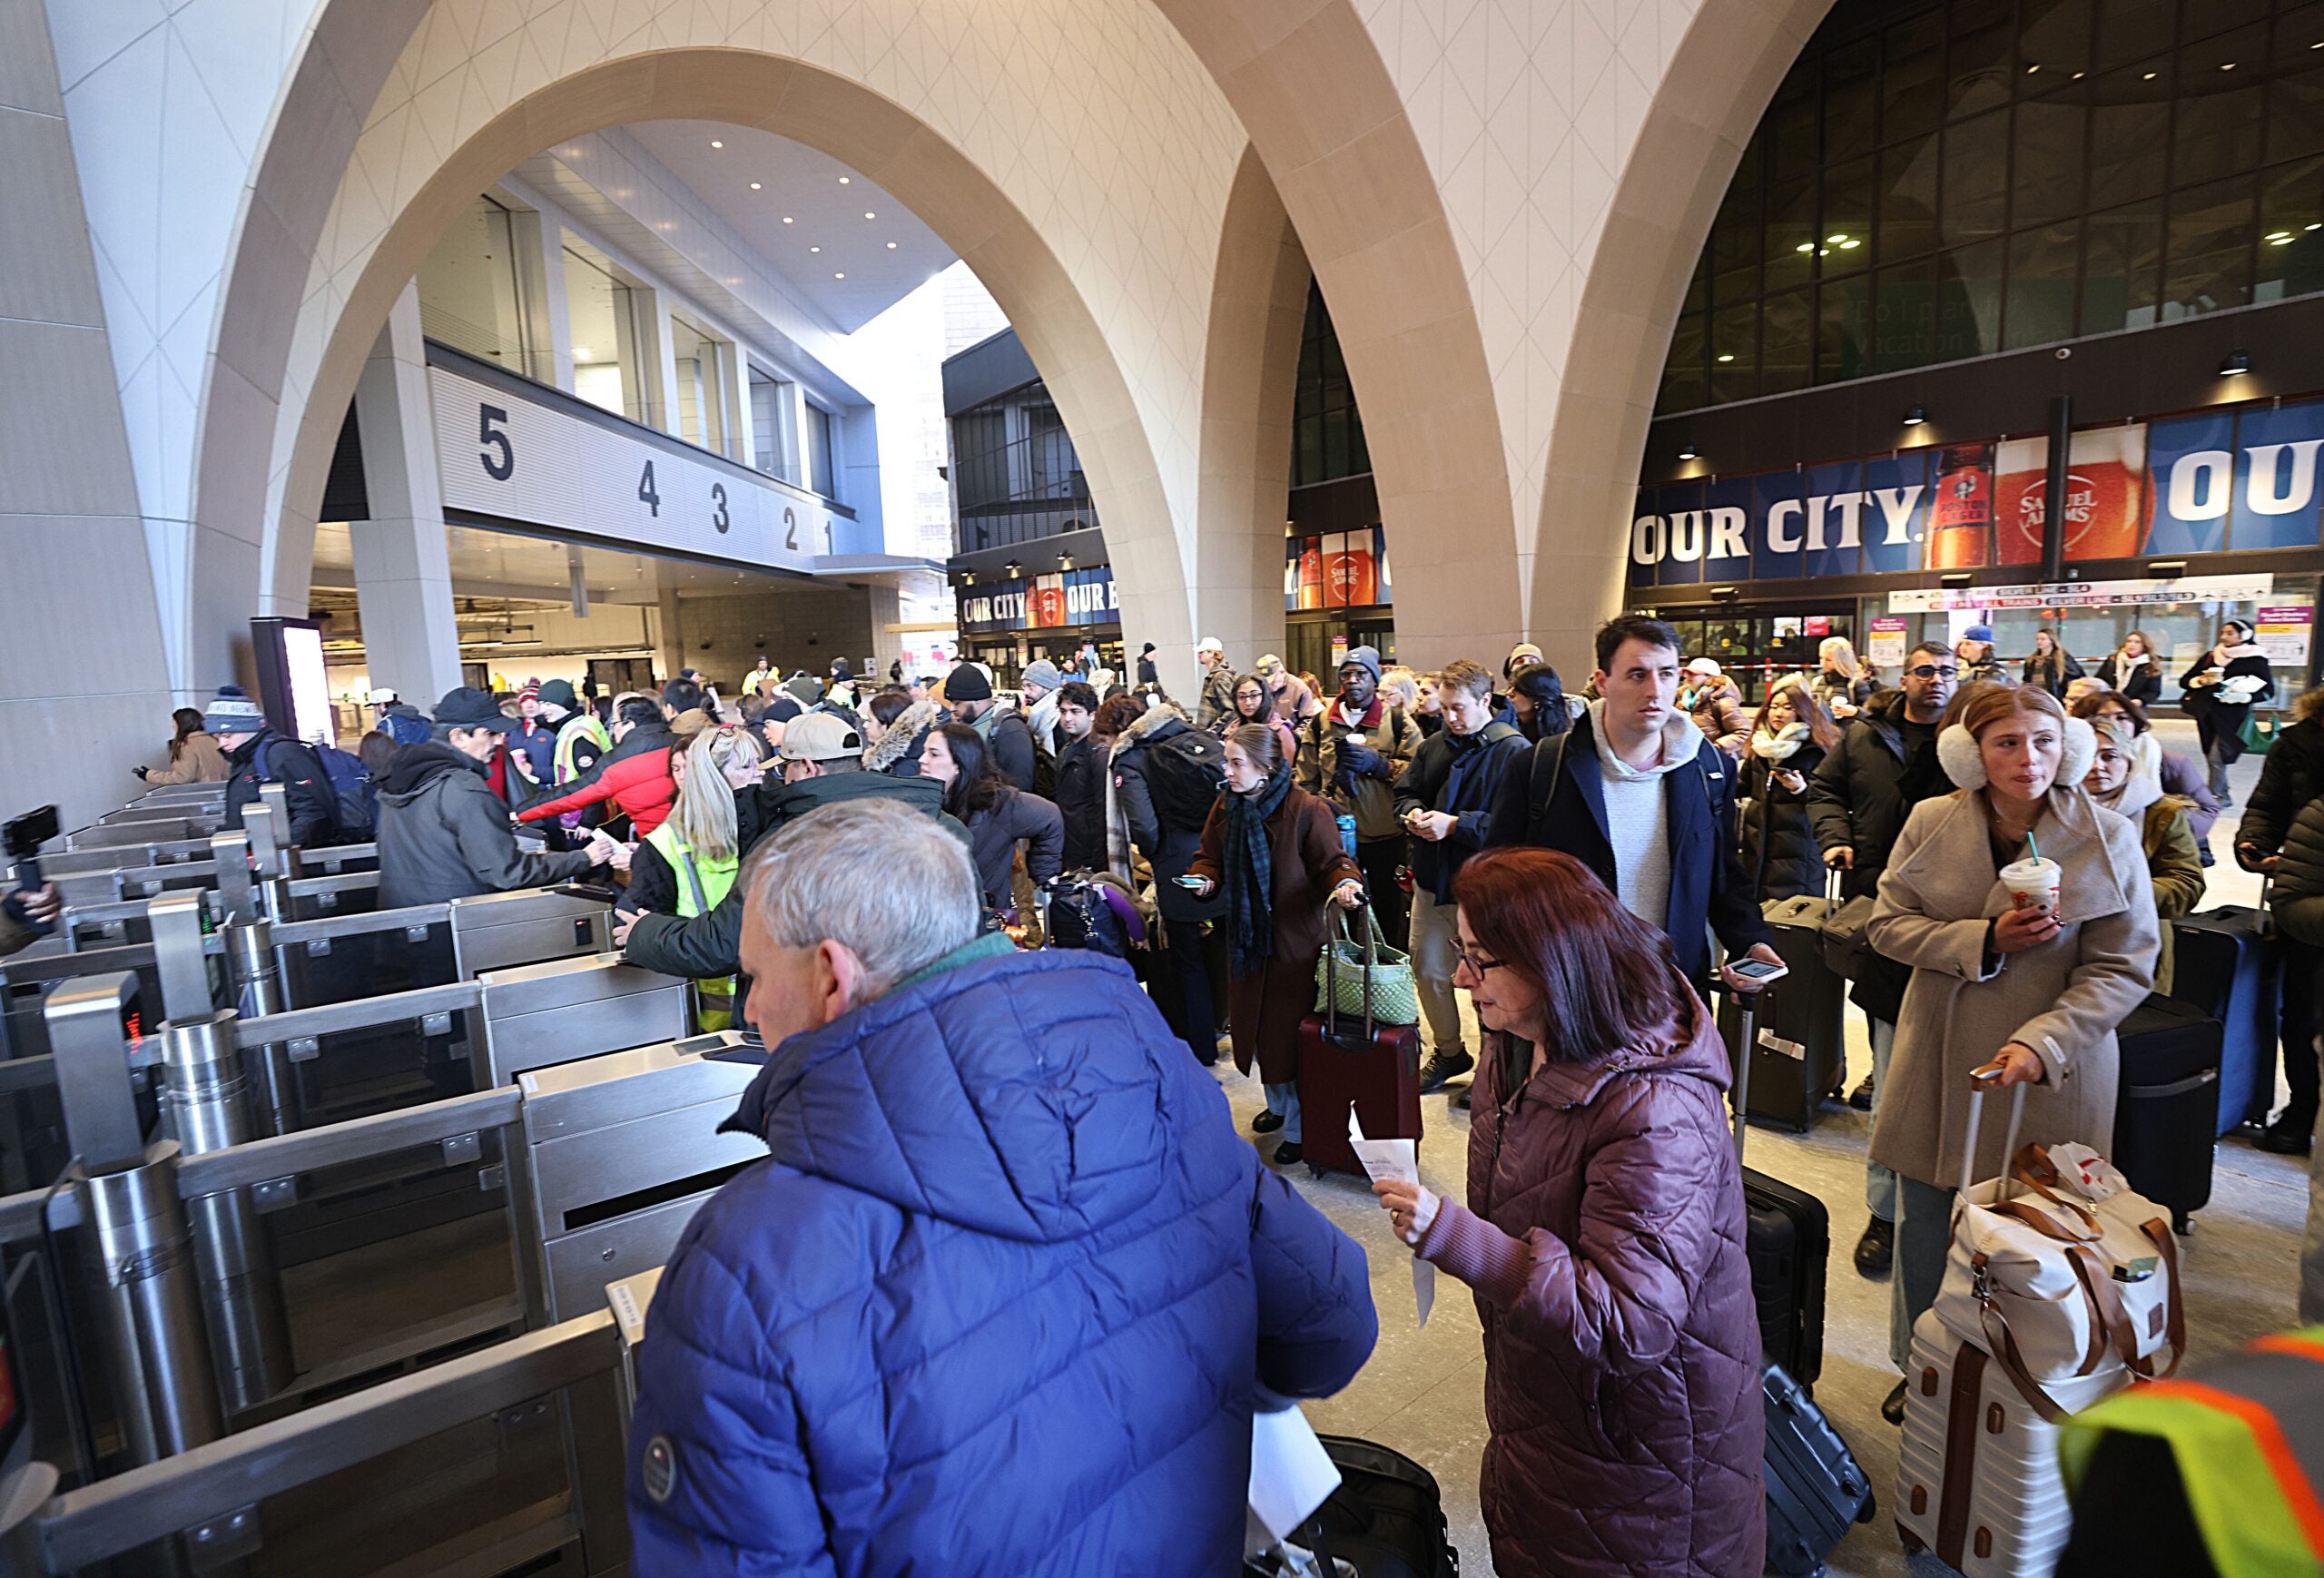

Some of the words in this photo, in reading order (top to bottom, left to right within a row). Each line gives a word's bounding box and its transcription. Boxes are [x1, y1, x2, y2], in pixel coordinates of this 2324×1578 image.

[480, 402, 514, 481] 5
[639, 459, 660, 518] 4
[712, 483, 729, 534] 3
[783, 507, 798, 550] 2
[824, 520, 833, 555] 1
[1633, 507, 1750, 565] OUR
[1767, 485, 1925, 553] CITY.
[2025, 507, 2090, 528] AMS
[963, 597, 992, 623] OUR
[1067, 583, 1106, 614] OUR
[2087, 596, 2112, 605] LINE
